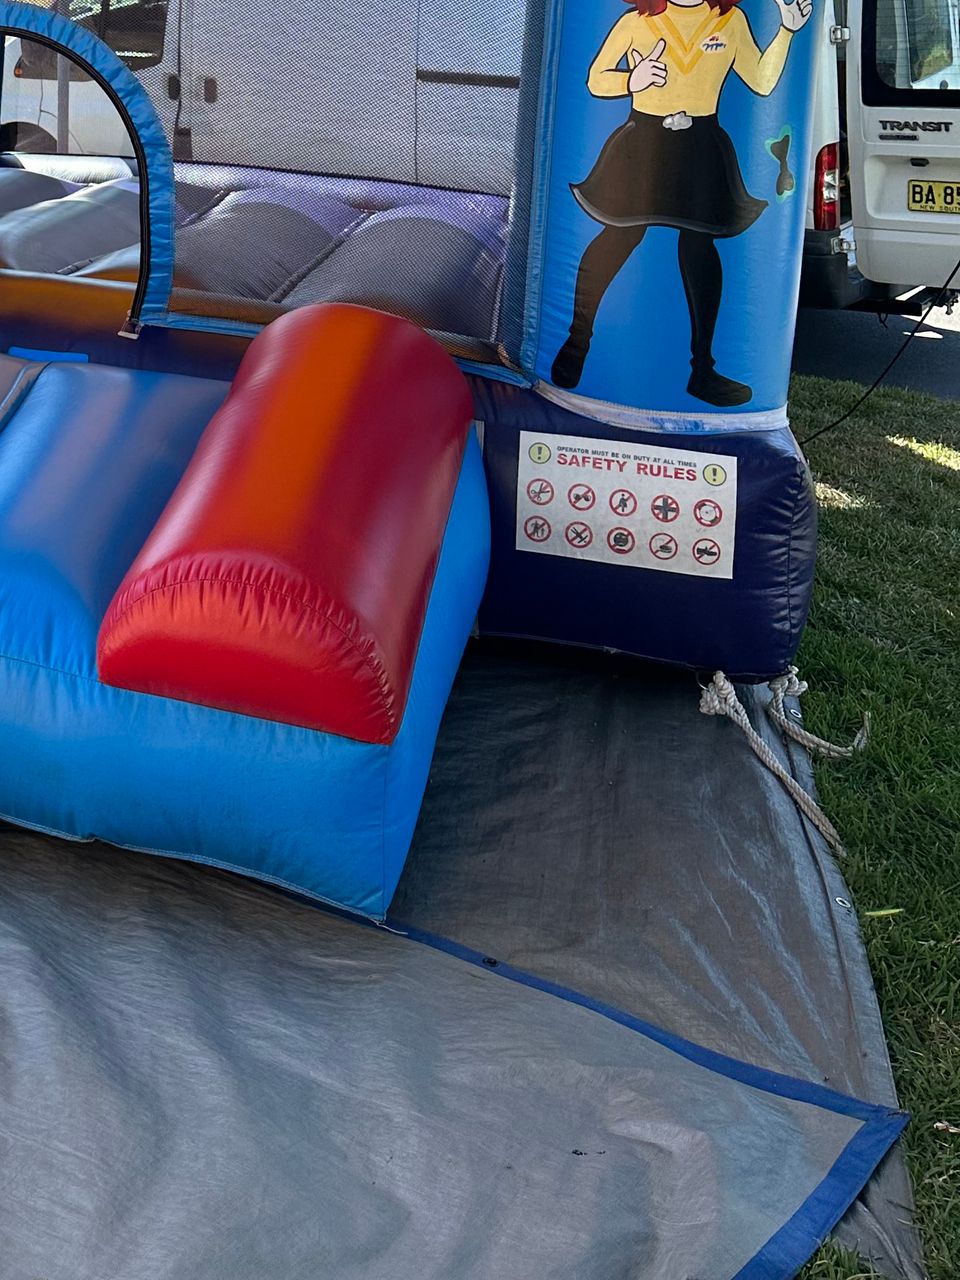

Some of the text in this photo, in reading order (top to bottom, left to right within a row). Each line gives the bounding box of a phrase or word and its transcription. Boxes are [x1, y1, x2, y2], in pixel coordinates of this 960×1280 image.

[879, 120, 953, 132] TRANSIT
[912, 184, 936, 205] BA
[556, 445, 590, 454] OPERATOR
[633, 454, 650, 462] DUTY
[663, 458, 675, 466] ALL
[678, 460, 697, 468] TIMES
[556, 452, 698, 481] SAFETY RULES
